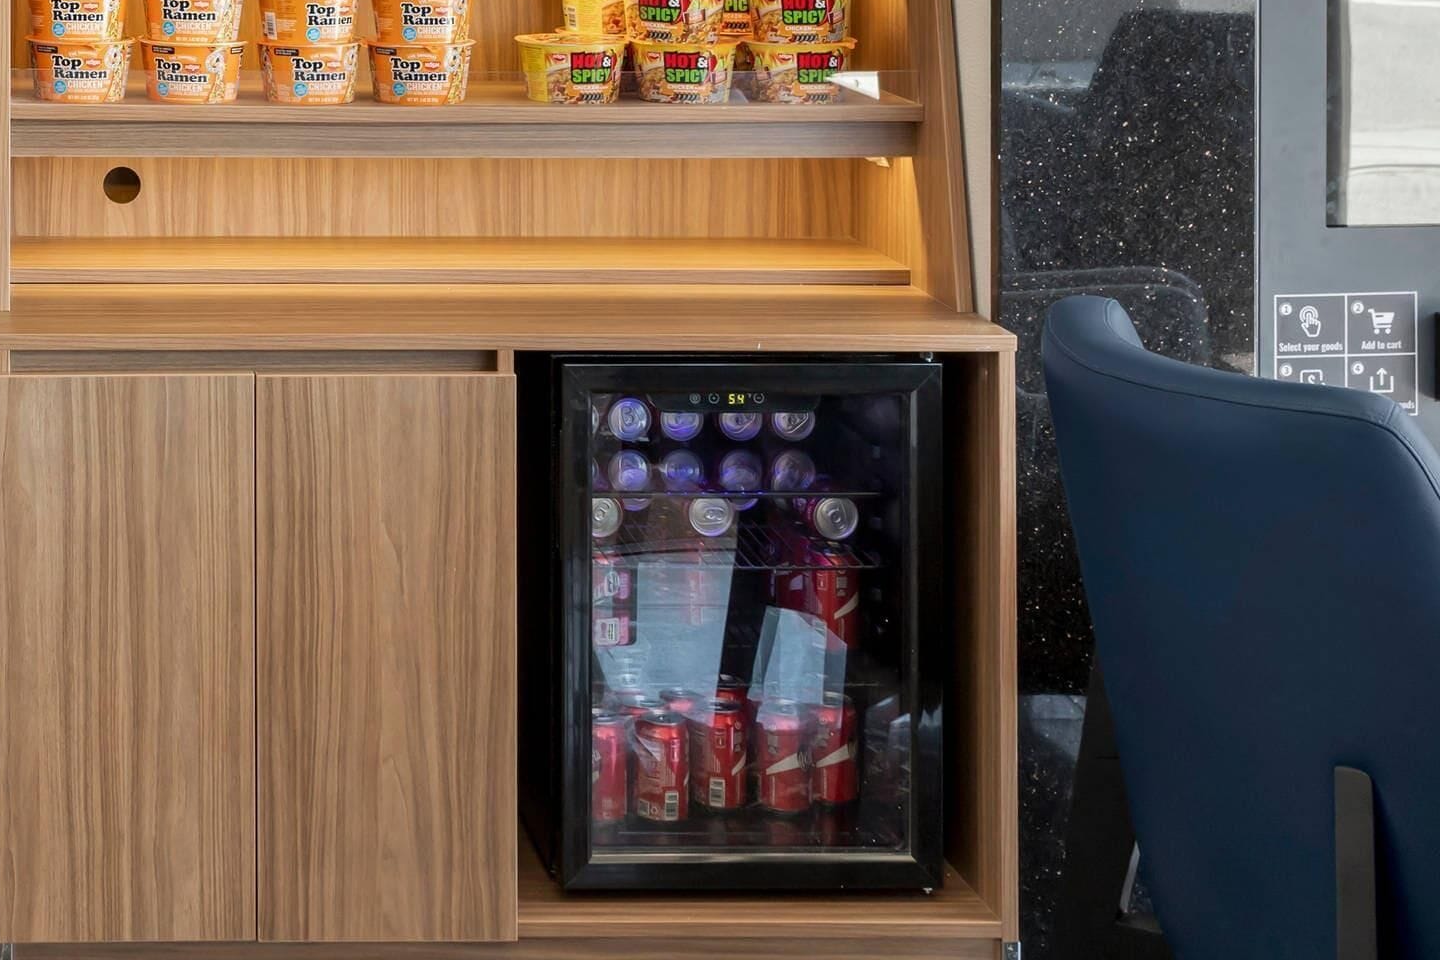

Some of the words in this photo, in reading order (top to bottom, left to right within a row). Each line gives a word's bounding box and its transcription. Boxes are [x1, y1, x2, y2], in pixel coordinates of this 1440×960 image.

[53, 10, 104, 21] Ramen
[162, 8, 216, 21] Ramen
[307, 4, 335, 17] Top
[401, 3, 431, 17] Top
[640, 6, 680, 22] SPICY
[783, 9, 826, 24] SPICY
[52, 55, 82, 70] Top
[155, 58, 181, 74] Top
[292, 58, 323, 72] Top
[390, 57, 420, 72] Top
[572, 53, 604, 68] HOT
[665, 53, 698, 68] HOT
[799, 53, 829, 69] HOT
[54, 66, 107, 79] Ramen
[157, 70, 208, 82] Ramen
[294, 70, 346, 81] Ramen
[392, 69, 447, 81] Ramen
[572, 68, 611, 83] SPICY
[666, 68, 708, 84] SPICY
[1278, 342, 1302, 353] Select
[1303, 343, 1320, 353] your
[1321, 341, 1344, 353] goods
[1361, 341, 1376, 350] Add
[1377, 341, 1386, 350] to
[1387, 340, 1402, 350] cart
[728, 393, 745, 405] 54
